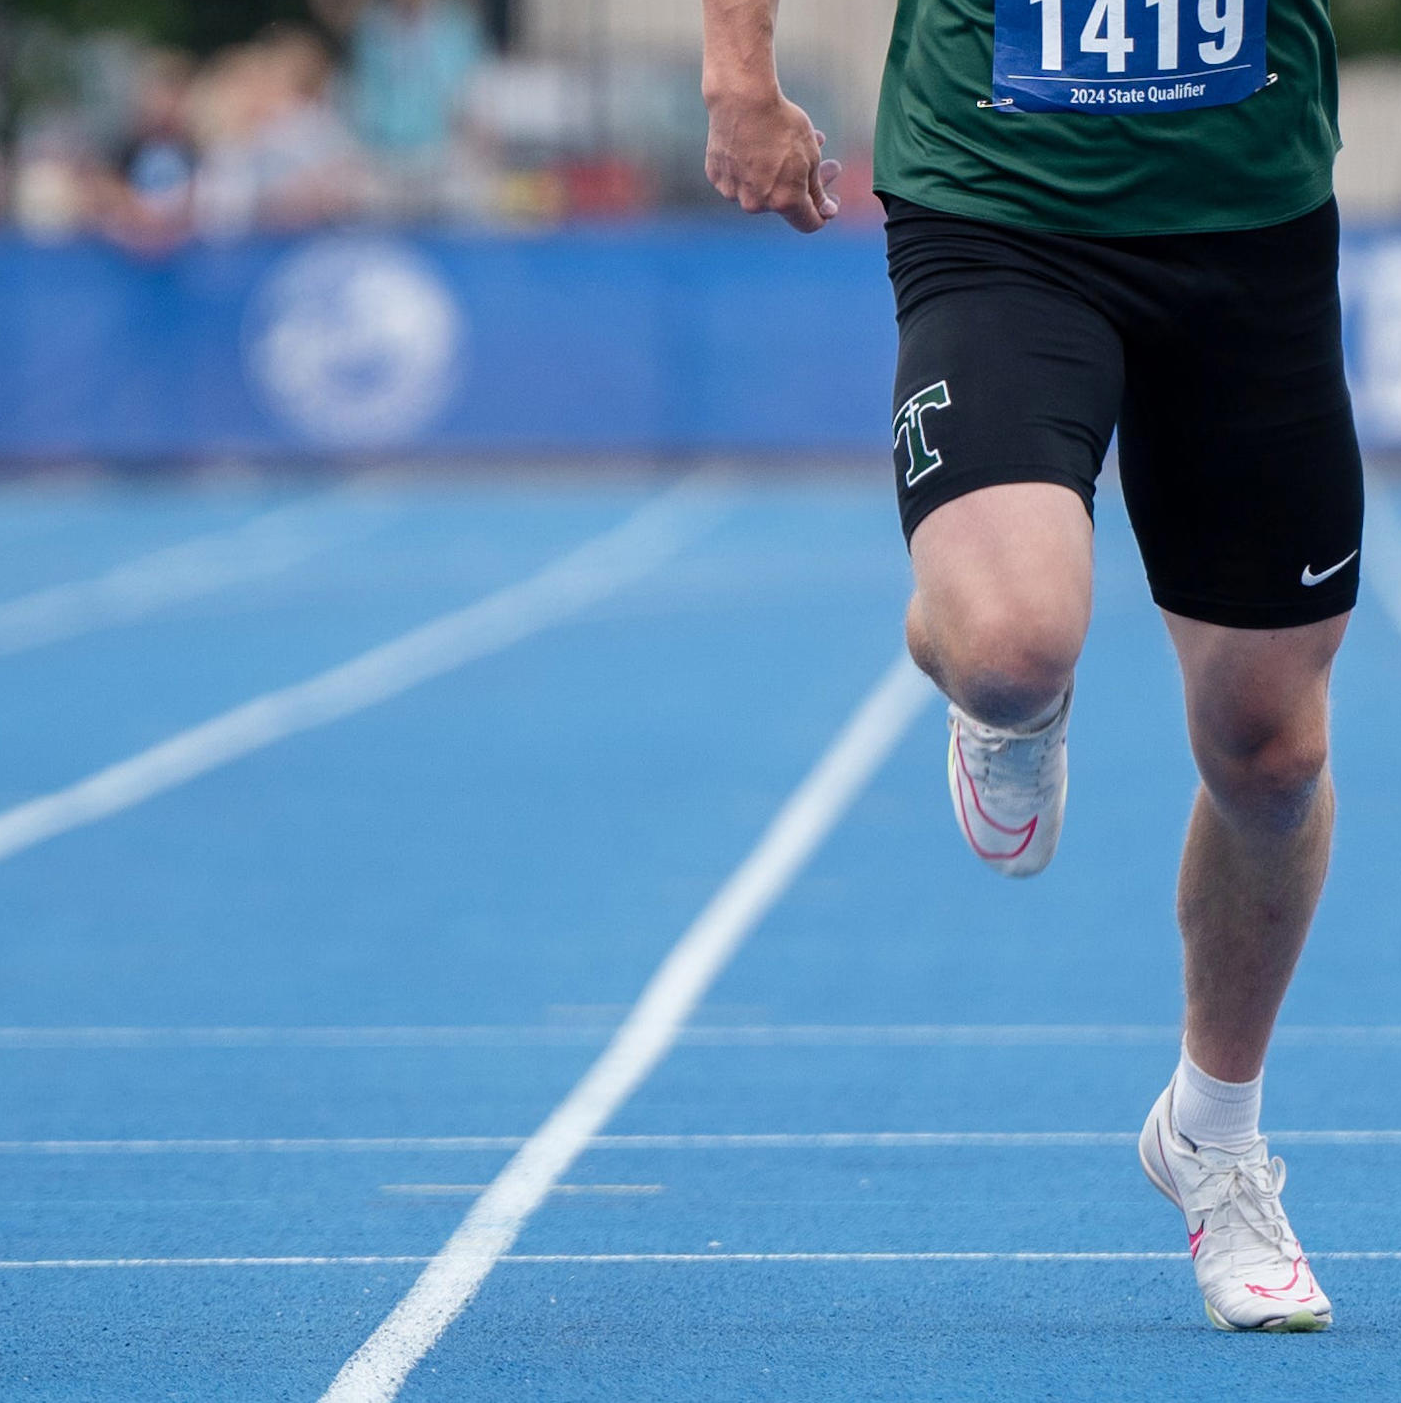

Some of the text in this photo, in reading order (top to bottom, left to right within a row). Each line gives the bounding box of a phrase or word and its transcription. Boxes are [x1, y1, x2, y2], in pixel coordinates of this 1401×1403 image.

[1070, 82, 1206, 104] 2024 State Qualifier
